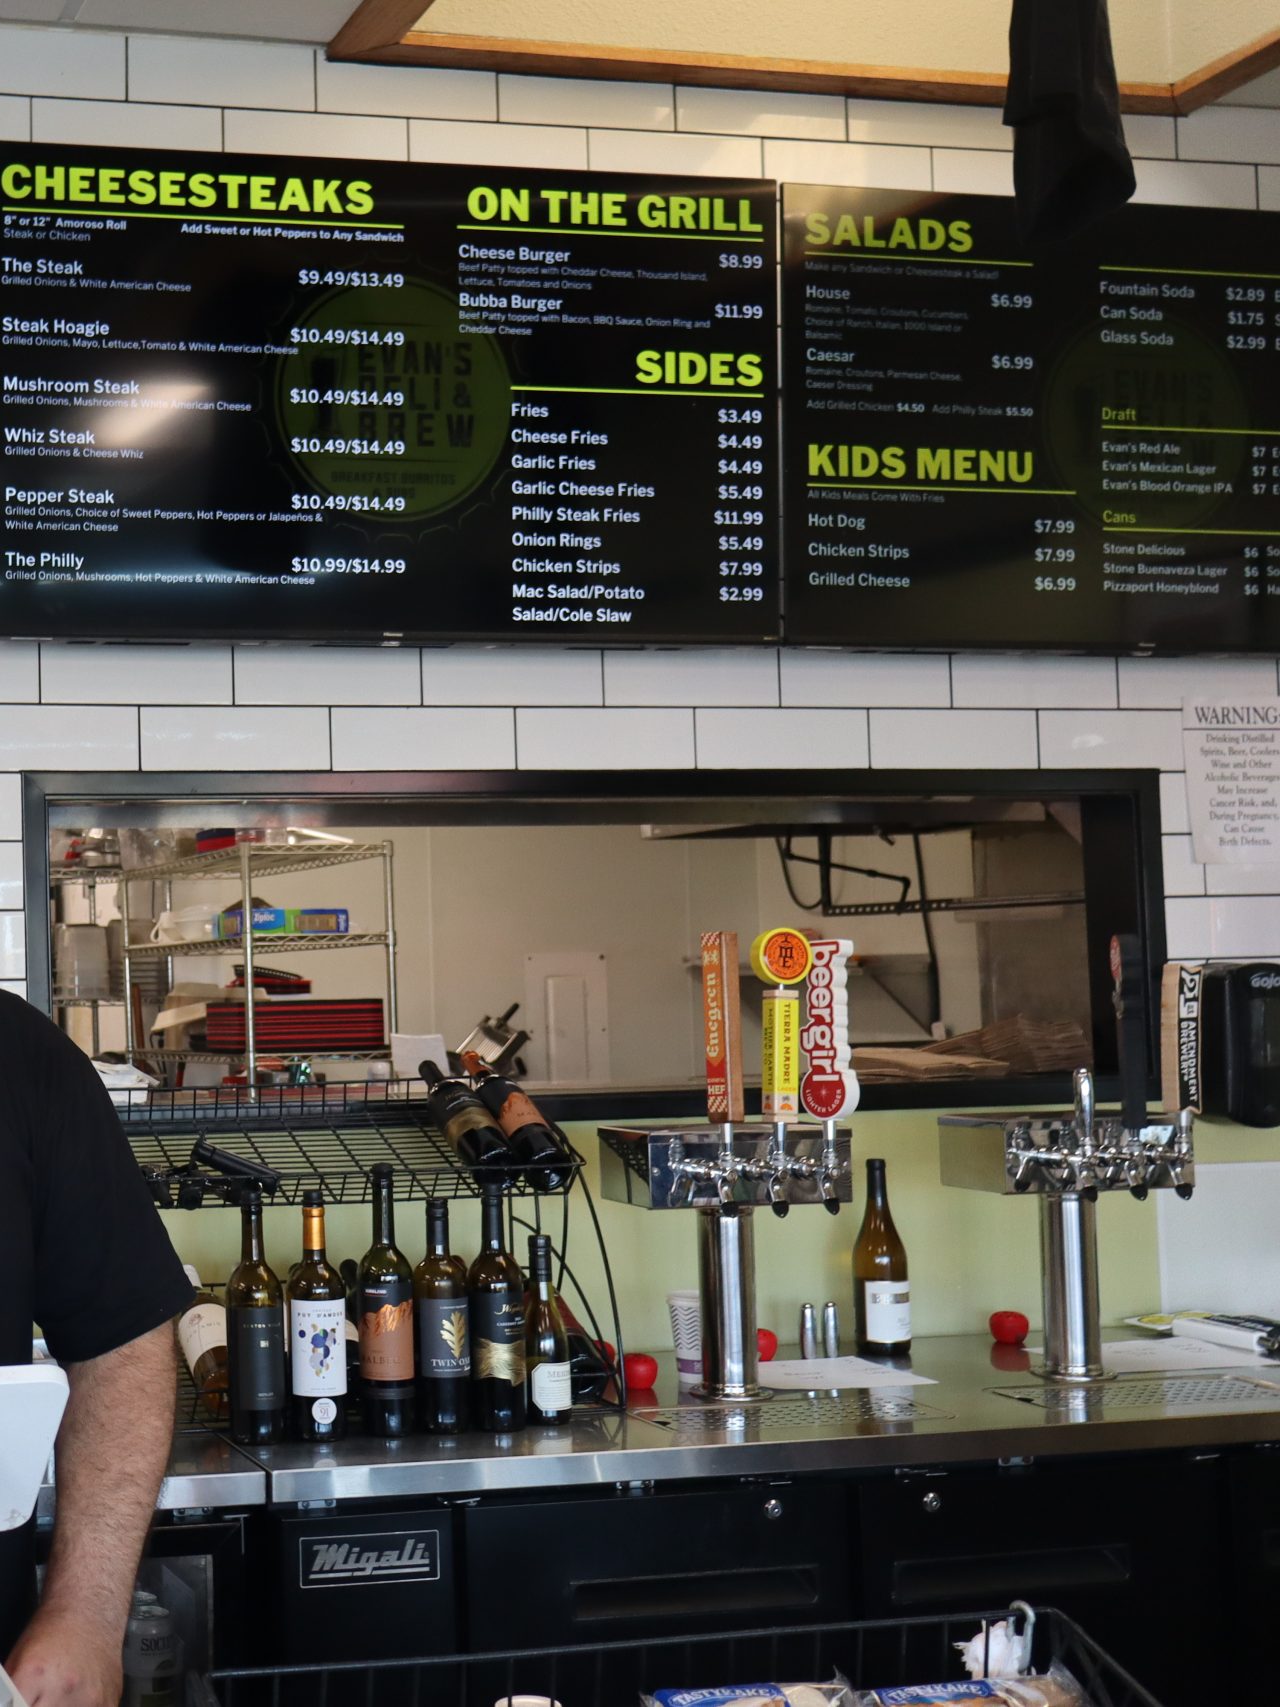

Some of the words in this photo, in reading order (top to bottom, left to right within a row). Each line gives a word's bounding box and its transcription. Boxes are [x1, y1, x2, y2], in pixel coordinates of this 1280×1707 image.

[0, 163, 376, 216] CHEESESTEAKS
[467, 186, 530, 222] ON
[540, 189, 628, 227] THE
[637, 194, 763, 233] GRILL
[180, 222, 203, 234] Add
[204, 223, 238, 235] Sweet
[239, 227, 252, 236] or
[252, 225, 273, 237] Hot
[273, 226, 318, 240] Peppers
[319, 229, 332, 240] to
[332, 229, 354, 242] Any
[354, 230, 405, 243] Sandwich
[803, 210, 974, 253] SALADS
[458, 243, 516, 260] Cheese
[518, 246, 571, 265] Burger
[719, 253, 763, 269] $8.99
[1, 256, 33, 273] The
[36, 258, 83, 275] Steak
[298, 268, 405, 288] $9.49/$13.49
[806, 284, 851, 300] House
[1099, 280, 1159, 297] Fountain
[1161, 283, 1195, 299] Soda
[1225, 286, 1266, 302] $2.89
[459, 292, 508, 308] Bubba
[510, 294, 563, 313] Burger
[990, 293, 1033, 309] $6.99
[714, 303, 764, 319] $11.99
[2, 316, 49, 333] Steak
[53, 319, 110, 338] Hoagie
[290, 327, 405, 346] $10.49/$14.49
[806, 347, 856, 363] Caesar
[991, 354, 1034, 370] $6.99
[635, 350, 763, 387] SIDES
[3, 375, 90, 393] Mushroom
[93, 378, 141, 395] Steak
[290, 387, 405, 407] $10.49/$14.49
[511, 402, 549, 418] Fries
[717, 408, 763, 424] $3.49
[1101, 406, 1137, 421] Draft
[4, 427, 45, 444] Whiz
[49, 428, 95, 444] Steak
[511, 428, 568, 444] Cheese
[570, 429, 609, 445] Fries
[717, 433, 763, 450] $4.49
[290, 437, 405, 455] $10.49/$14.49
[1251, 445, 1266, 458] $7
[808, 443, 907, 479] KIDS
[916, 447, 1033, 483] MENU
[5, 486, 65, 505] Pepper
[68, 488, 115, 504] Steak
[291, 493, 406, 512] $10.49/$14.49
[511, 505, 554, 524] Philly
[556, 506, 600, 522] Steak
[603, 507, 641, 523] Fries
[714, 510, 764, 526] $11.99
[808, 513, 834, 528] Hot
[837, 513, 866, 531] Dog
[1102, 509, 1137, 524] Cans
[1034, 518, 1075, 534] $7.99
[511, 531, 557, 547] Onion
[559, 532, 602, 551] Rings
[718, 535, 763, 551] $5.49
[4, 551, 36, 567] The
[40, 552, 85, 571] Philly
[291, 556, 406, 574] $10.99/$14.99
[511, 557, 573, 573] Chicken
[575, 558, 621, 576] Strips
[719, 560, 763, 576] $7.99
[1206, 733, 1239, 745] Drinking
[1241, 733, 1275, 744] Distilled
[1248, 758, 1272, 769] Other
[799, 940, 840, 1083] beergirl
[783, 1002, 792, 1042] TIERRA
[783, 1046, 792, 1085] MADRE
[1188, 1020, 1198, 1102] AMENDMENT
[707, 1084, 726, 1096] HEF
[805, 1089, 826, 1113] LIGHTER
[827, 1088, 842, 1112] LAGER
[430, 1358, 457, 1368] TWIN
[311, 1539, 431, 1576] Migali
